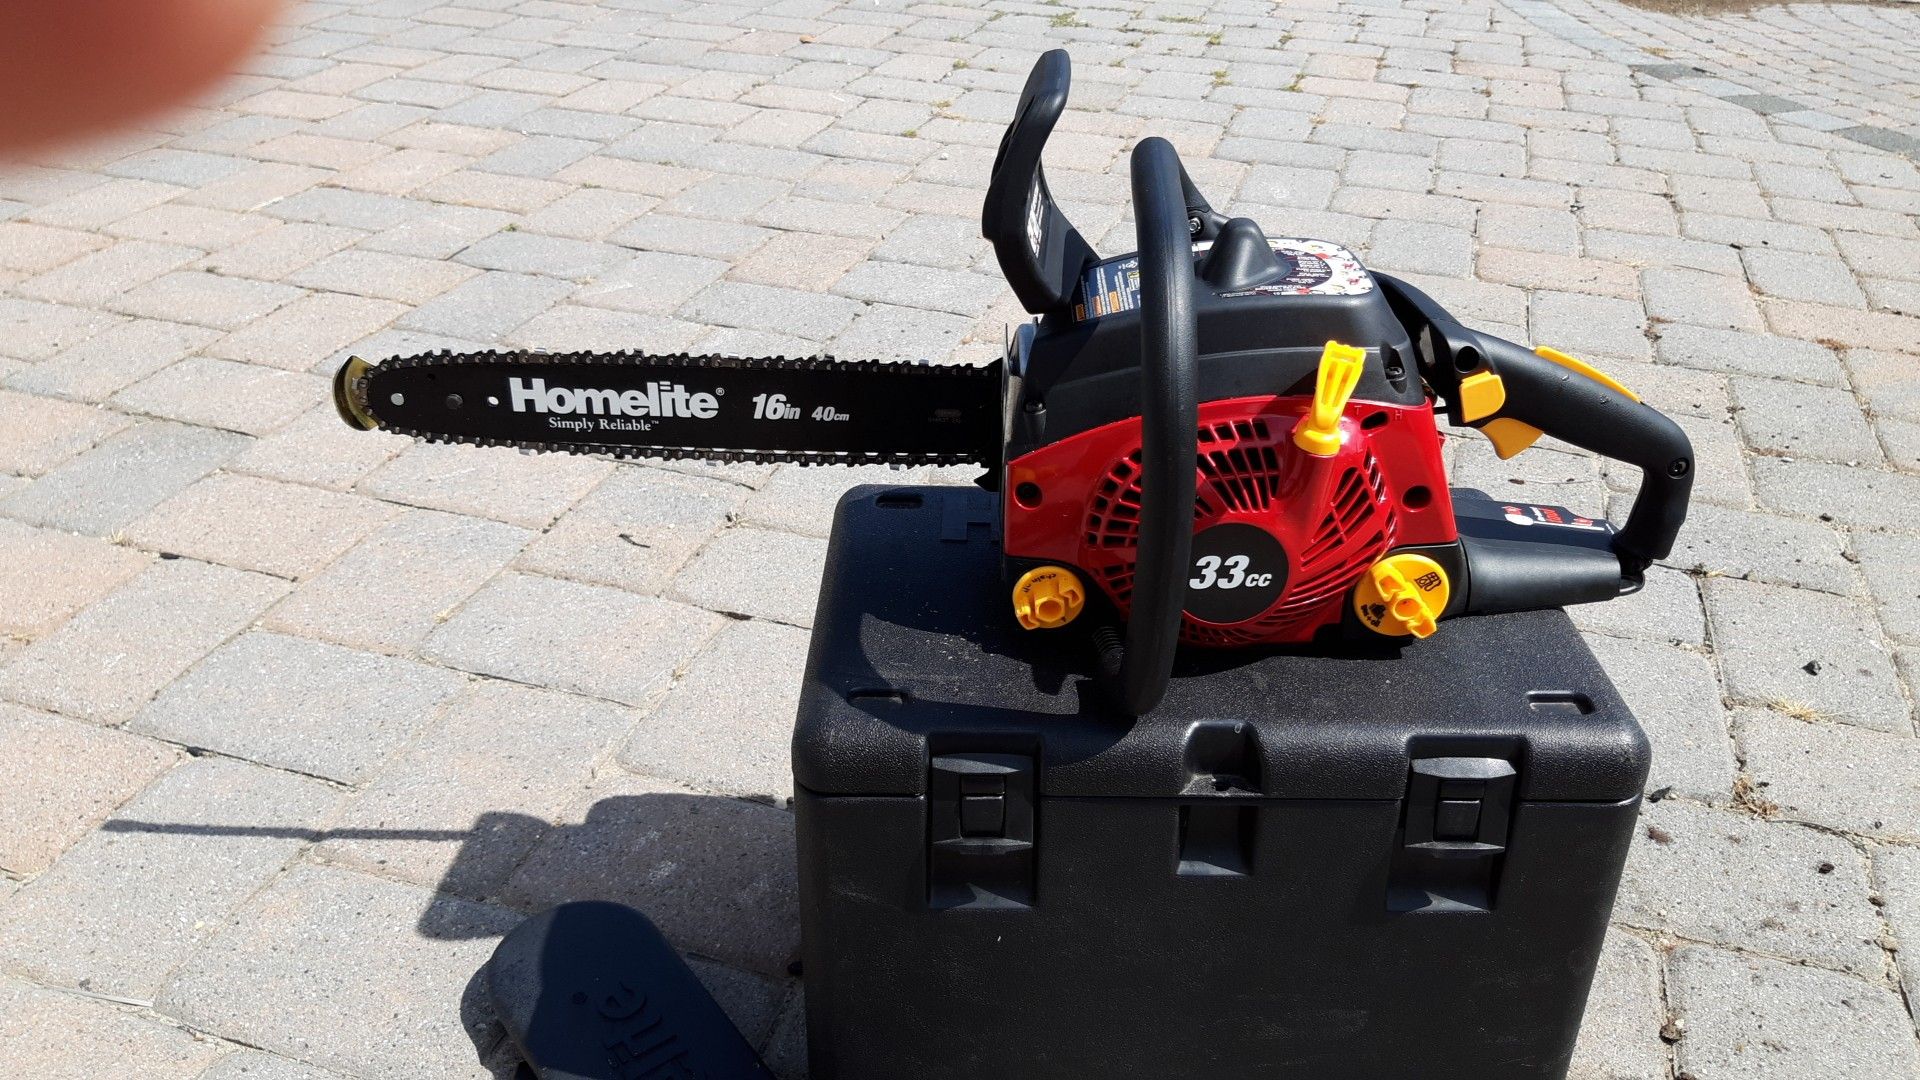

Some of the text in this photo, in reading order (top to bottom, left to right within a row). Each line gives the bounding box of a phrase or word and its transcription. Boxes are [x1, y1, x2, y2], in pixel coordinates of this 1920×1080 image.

[752, 393, 850, 422] 16in 40cm
[548, 416, 595, 433] Simply
[1188, 554, 1272, 590] 33cc
